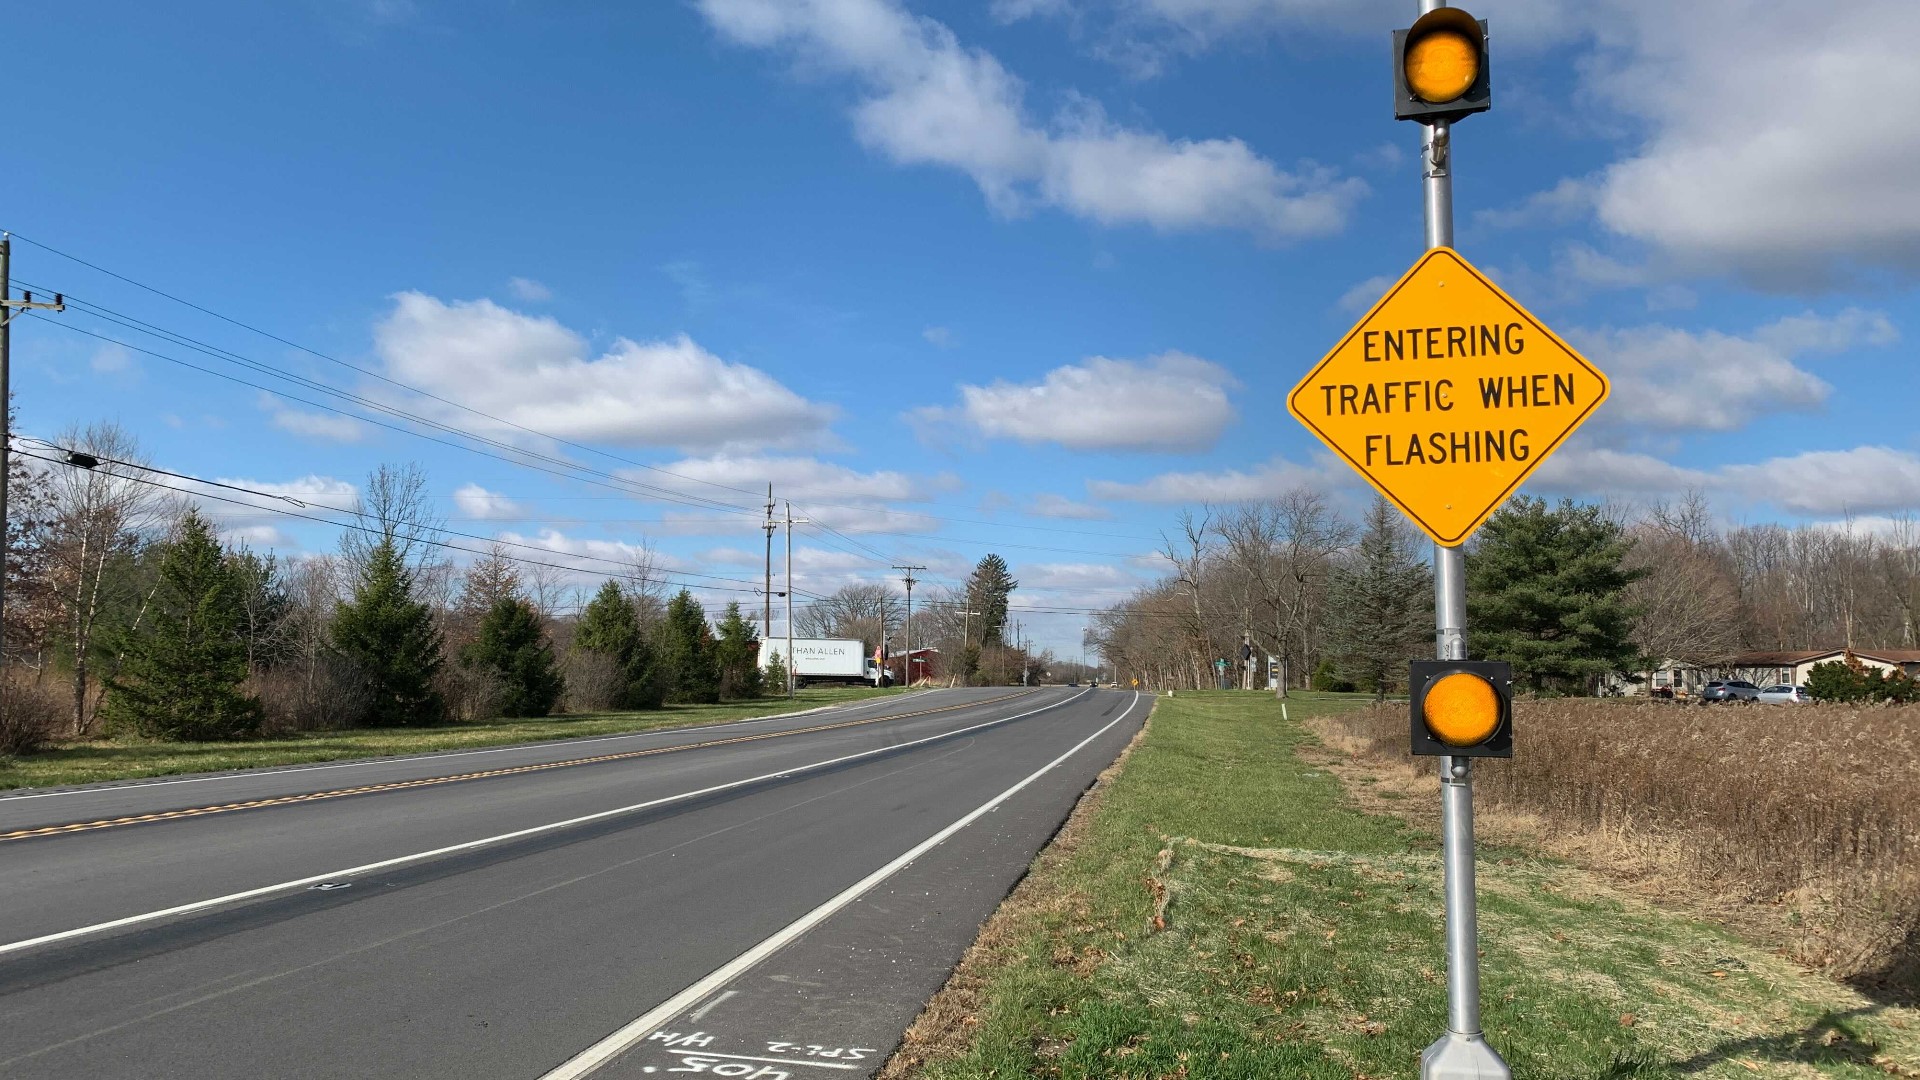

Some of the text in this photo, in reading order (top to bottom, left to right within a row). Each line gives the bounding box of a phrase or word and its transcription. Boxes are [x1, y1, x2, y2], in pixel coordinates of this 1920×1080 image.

[1363, 322, 1525, 363] ENTERING
[1320, 372, 1575, 416] TRAFFIC WHEN
[1365, 428, 1530, 467] FLASHING
[817, 647, 845, 656] ALLEN
